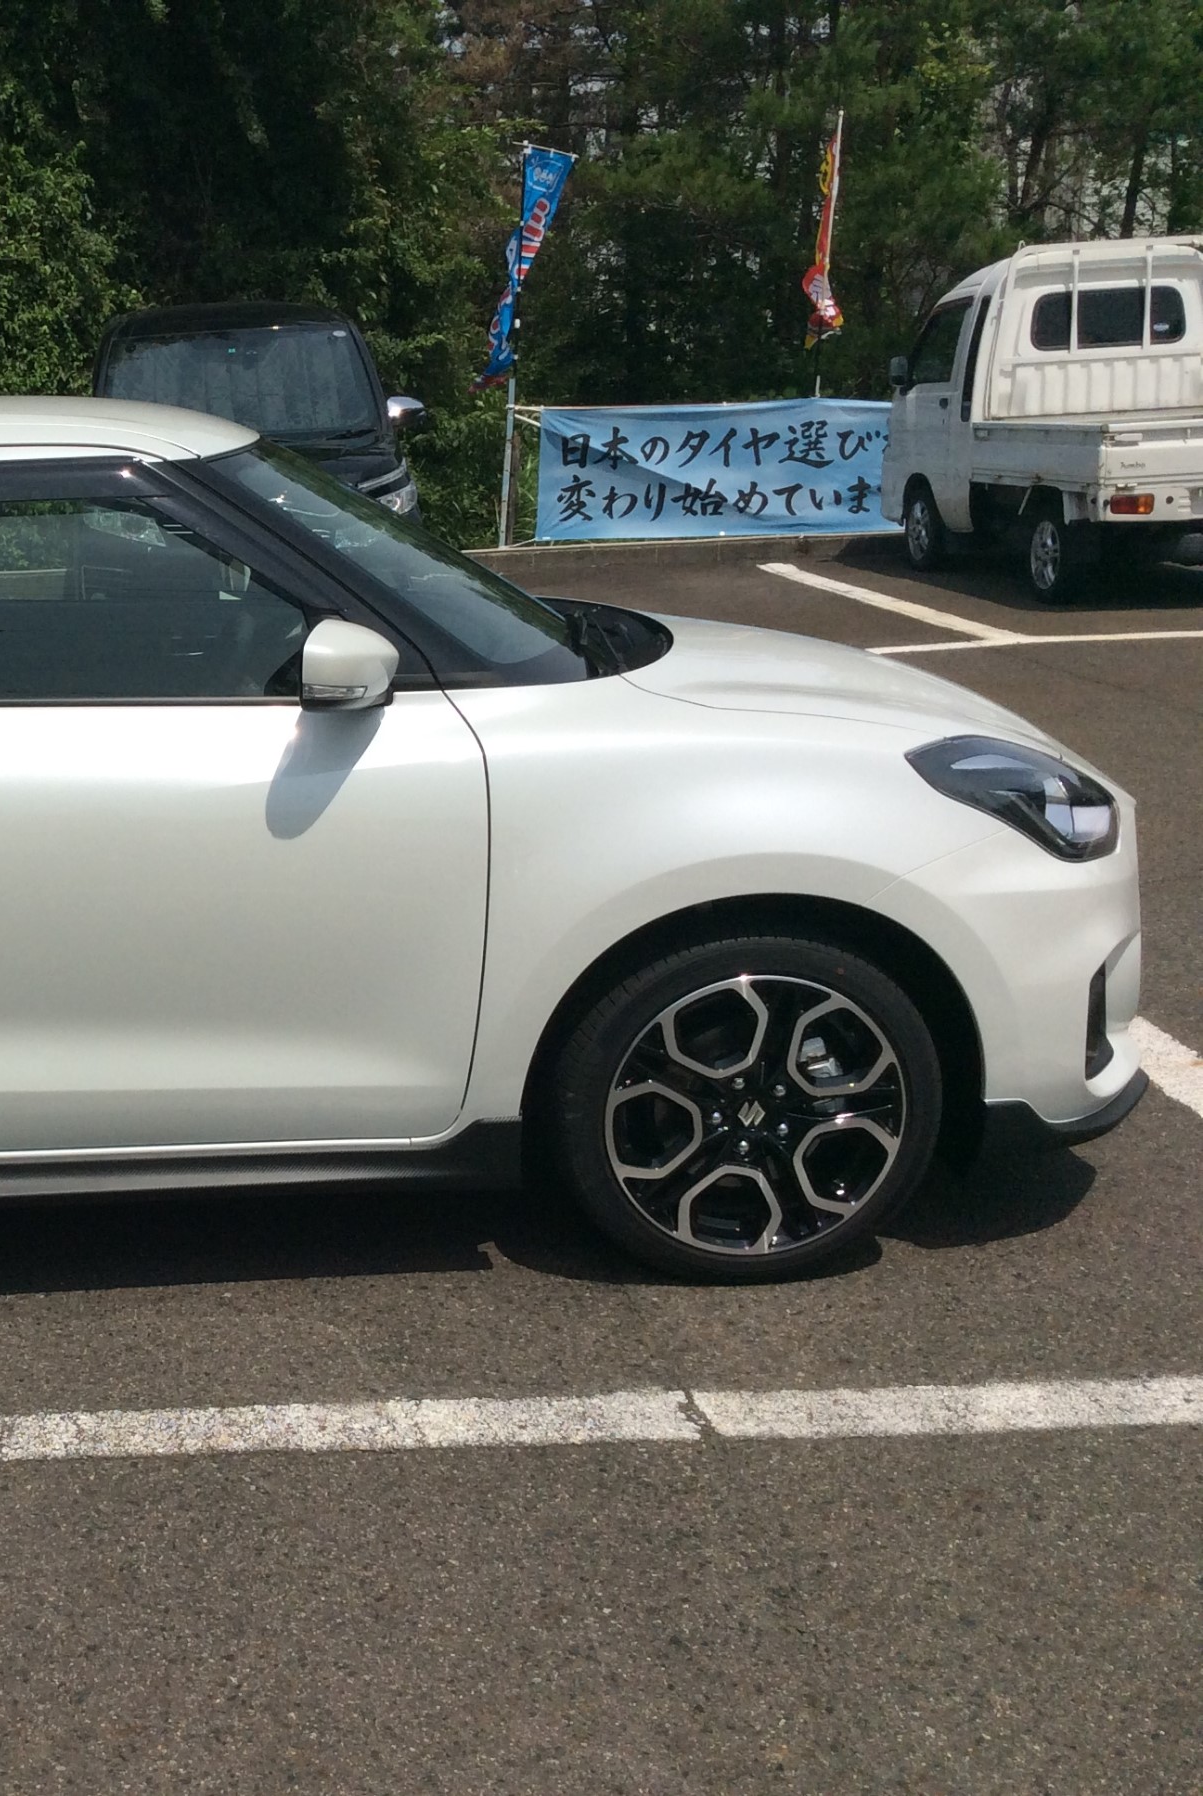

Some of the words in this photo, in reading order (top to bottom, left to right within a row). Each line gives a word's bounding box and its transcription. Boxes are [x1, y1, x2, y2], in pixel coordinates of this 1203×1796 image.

[561, 419, 891, 469] 日本のタイヤ選び
[556, 474, 882, 523] 変わり始めていま
